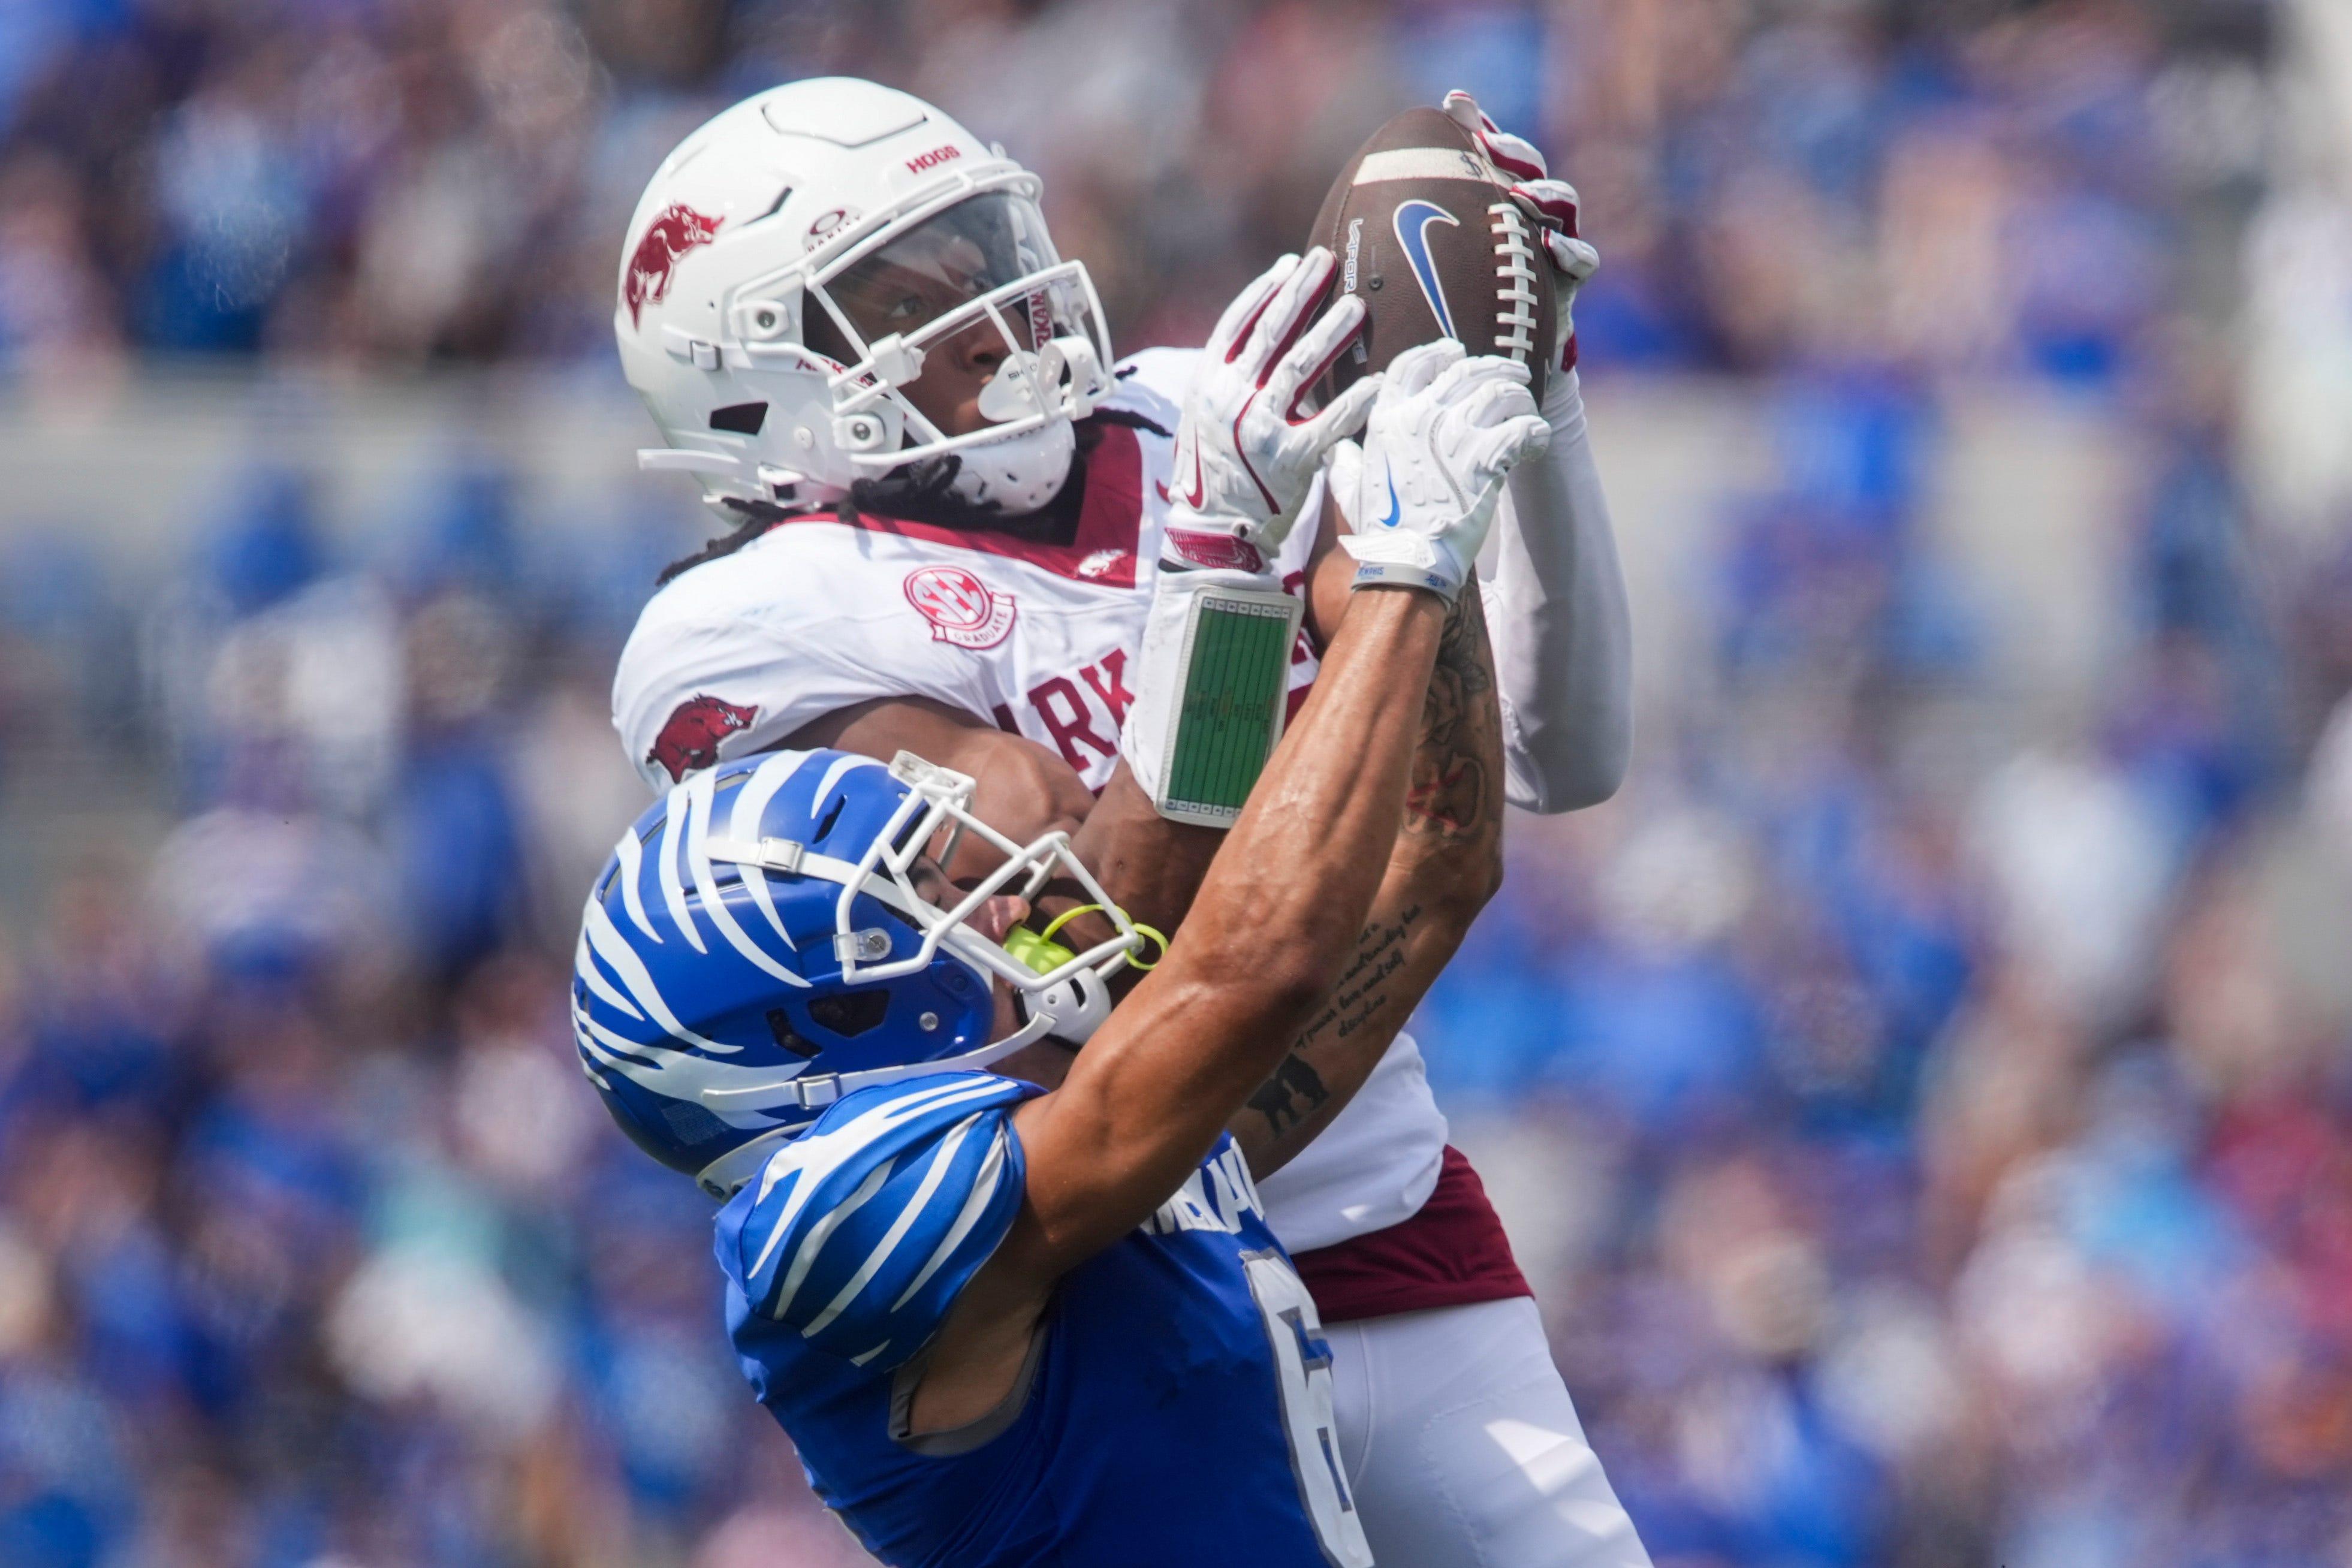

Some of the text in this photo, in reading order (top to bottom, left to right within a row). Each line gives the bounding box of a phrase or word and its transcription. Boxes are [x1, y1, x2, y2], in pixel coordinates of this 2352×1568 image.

[905, 145, 961, 174] HOGS
[1344, 218, 1364, 294] VAPOR
[954, 611, 1008, 643] GRADUATE
